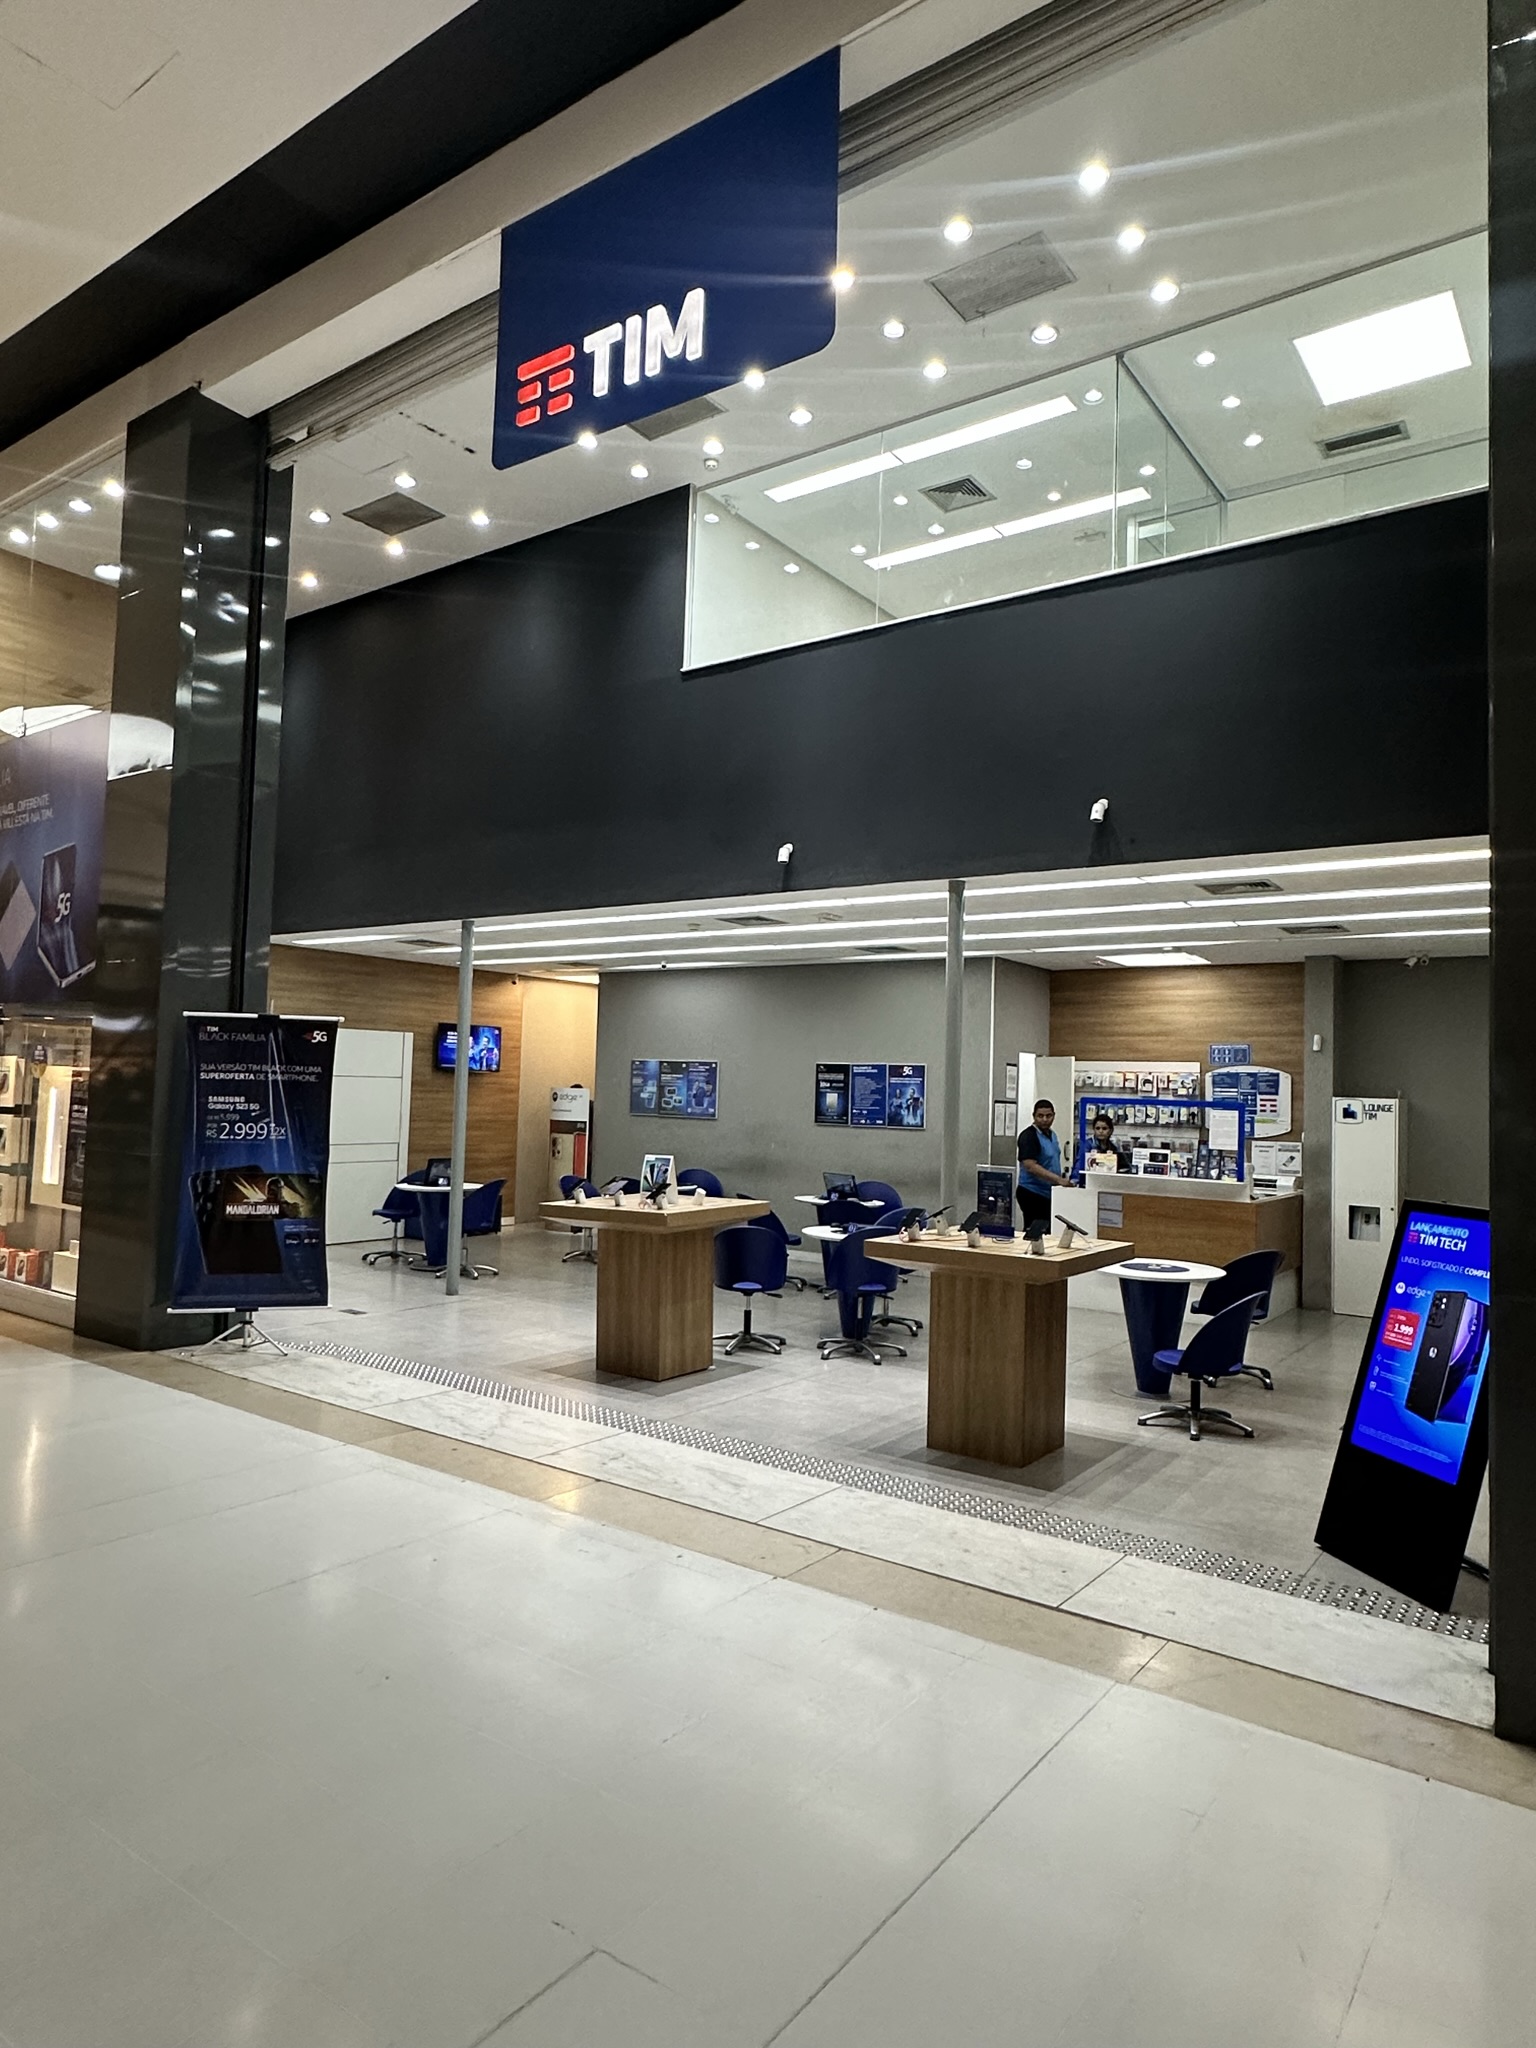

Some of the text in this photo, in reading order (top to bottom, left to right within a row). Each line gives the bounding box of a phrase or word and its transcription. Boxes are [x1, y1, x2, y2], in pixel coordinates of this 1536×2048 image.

[583, 287, 705, 398] TIM
[55, 893, 71, 923] 5G
[199, 1032, 230, 1041] BLACK
[311, 1030, 328, 1043] 5G
[200, 1063, 216, 1071] SUA
[248, 1064, 261, 1072] TIM
[287, 1065, 304, 1073] COM
[902, 1066, 913, 1076] 5G
[200, 1072, 255, 1081] SUPEROFERTA
[255, 1073, 266, 1081] DE
[208, 1095, 246, 1103] SAMSUNG
[207, 1102, 235, 1112] Galaxy
[1363, 1103, 1394, 1113] LOUNGE
[1364, 1112, 1378, 1121] TIM
[219, 1122, 268, 1140] 2.999
[225, 1204, 280, 1215] MANDALORIAN
[1410, 1221, 1470, 1239] LANÇAMENTO
[1419, 1233, 1467, 1252] TIM TECH
[1464, 1267, 1490, 1280] COMPL
[1406, 1286, 1427, 1299] edge
[1393, 1322, 1414, 1336] 1.999
